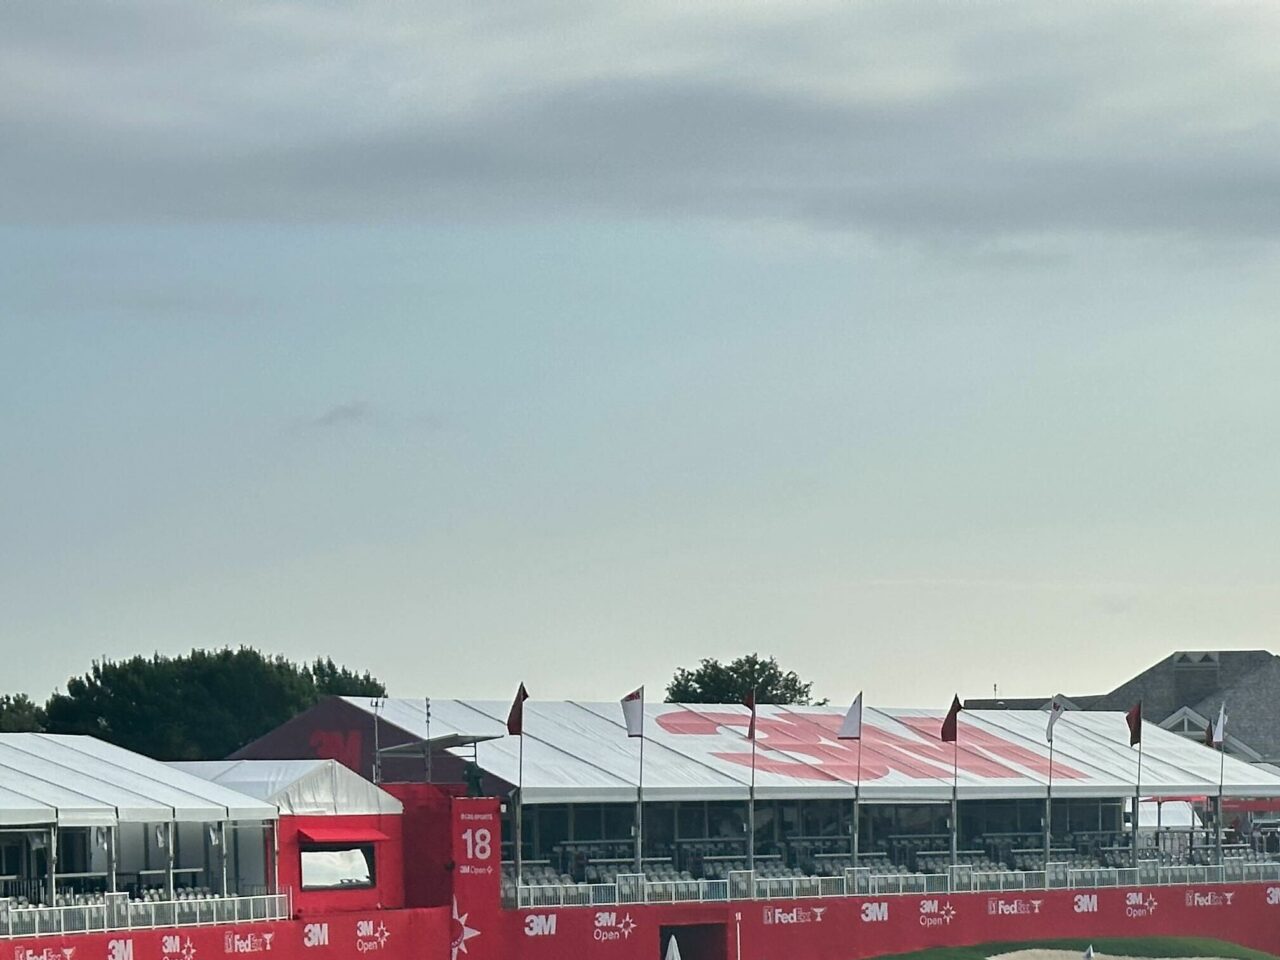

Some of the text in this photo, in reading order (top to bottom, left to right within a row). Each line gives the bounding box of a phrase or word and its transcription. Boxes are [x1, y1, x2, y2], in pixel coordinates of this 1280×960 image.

[655, 711, 1092, 781] 3M
[462, 828, 491, 860] 18
[920, 900, 938, 914] 3M
[1074, 895, 1098, 913] 3M
[1126, 892, 1143, 905] 3M
[594, 912, 616, 927] 3M
[861, 902, 888, 922] 3M
[1126, 906, 1147, 919] Open
[356, 920, 374, 937] 3M
[524, 914, 557, 936] 3M
[919, 915, 943, 928] Open
[304, 923, 328, 947] 3M
[593, 928, 620, 941] Open
[162, 935, 180, 953] 3M
[356, 939, 377, 953] Open
